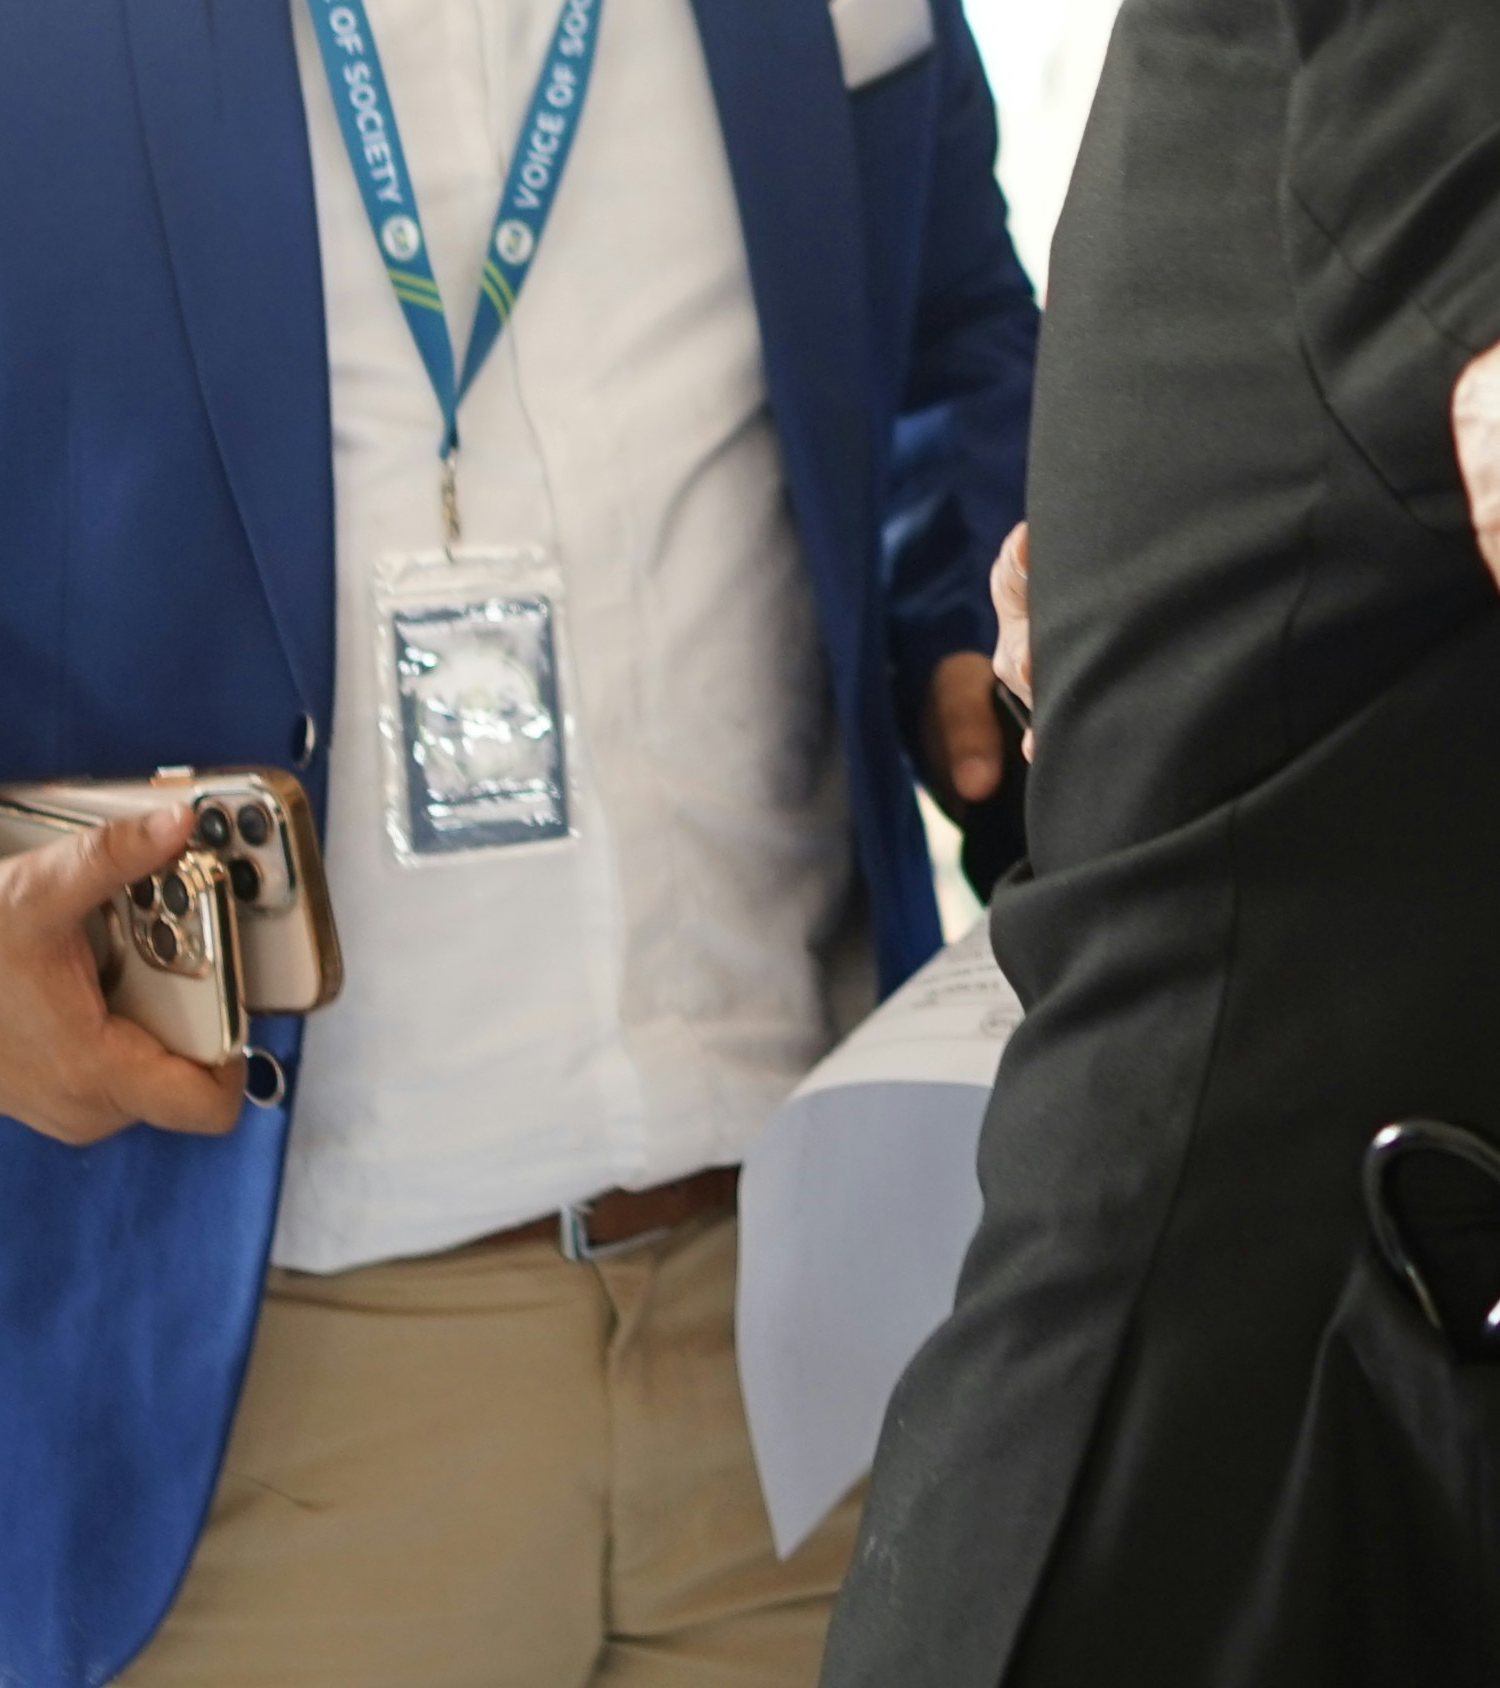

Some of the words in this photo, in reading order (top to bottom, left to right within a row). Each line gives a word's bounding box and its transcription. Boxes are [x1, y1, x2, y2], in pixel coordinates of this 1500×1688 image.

[329, 6, 364, 56] OF
[344, 62, 402, 203] SOCIETY
[513, 112, 566, 209] VOICE
[545, 62, 577, 108] OF
